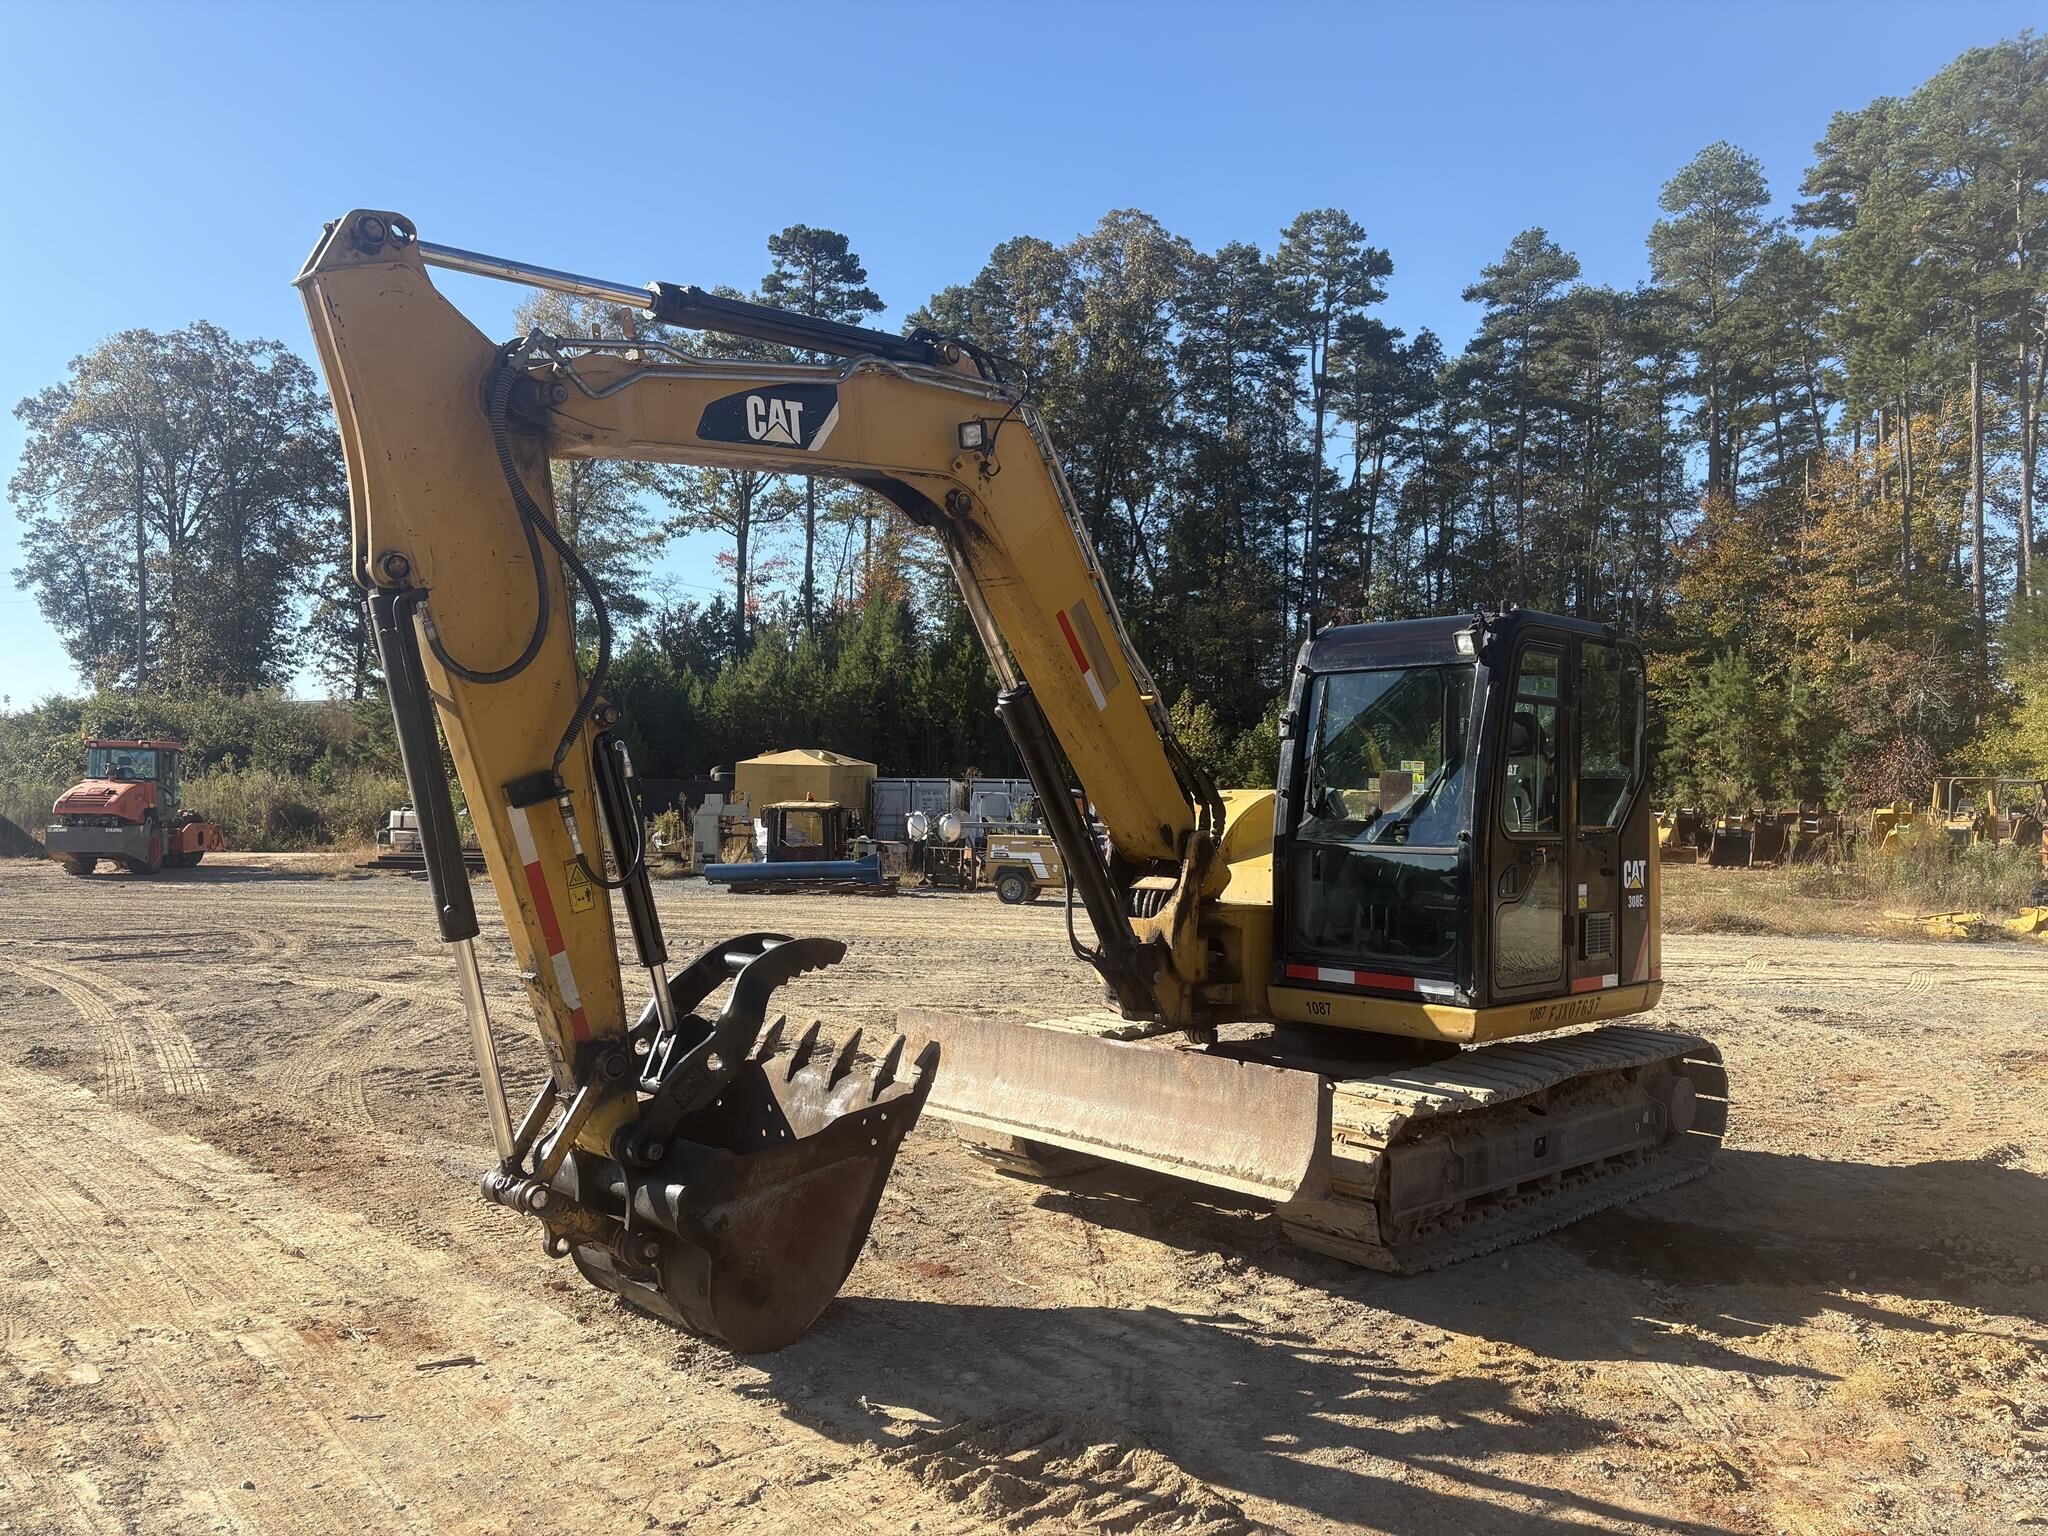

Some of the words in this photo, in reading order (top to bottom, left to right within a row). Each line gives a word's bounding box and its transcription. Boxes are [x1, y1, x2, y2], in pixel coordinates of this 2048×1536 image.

[746, 395, 804, 445] CAT
[1507, 764, 1518, 775] AT
[1623, 860, 1646, 889] CAT
[1627, 894, 1643, 908] 308E
[1305, 1001, 1331, 1015] 1087
[1529, 1006, 1547, 1022] 1087
[1548, 996, 1602, 1022] FJX07637
